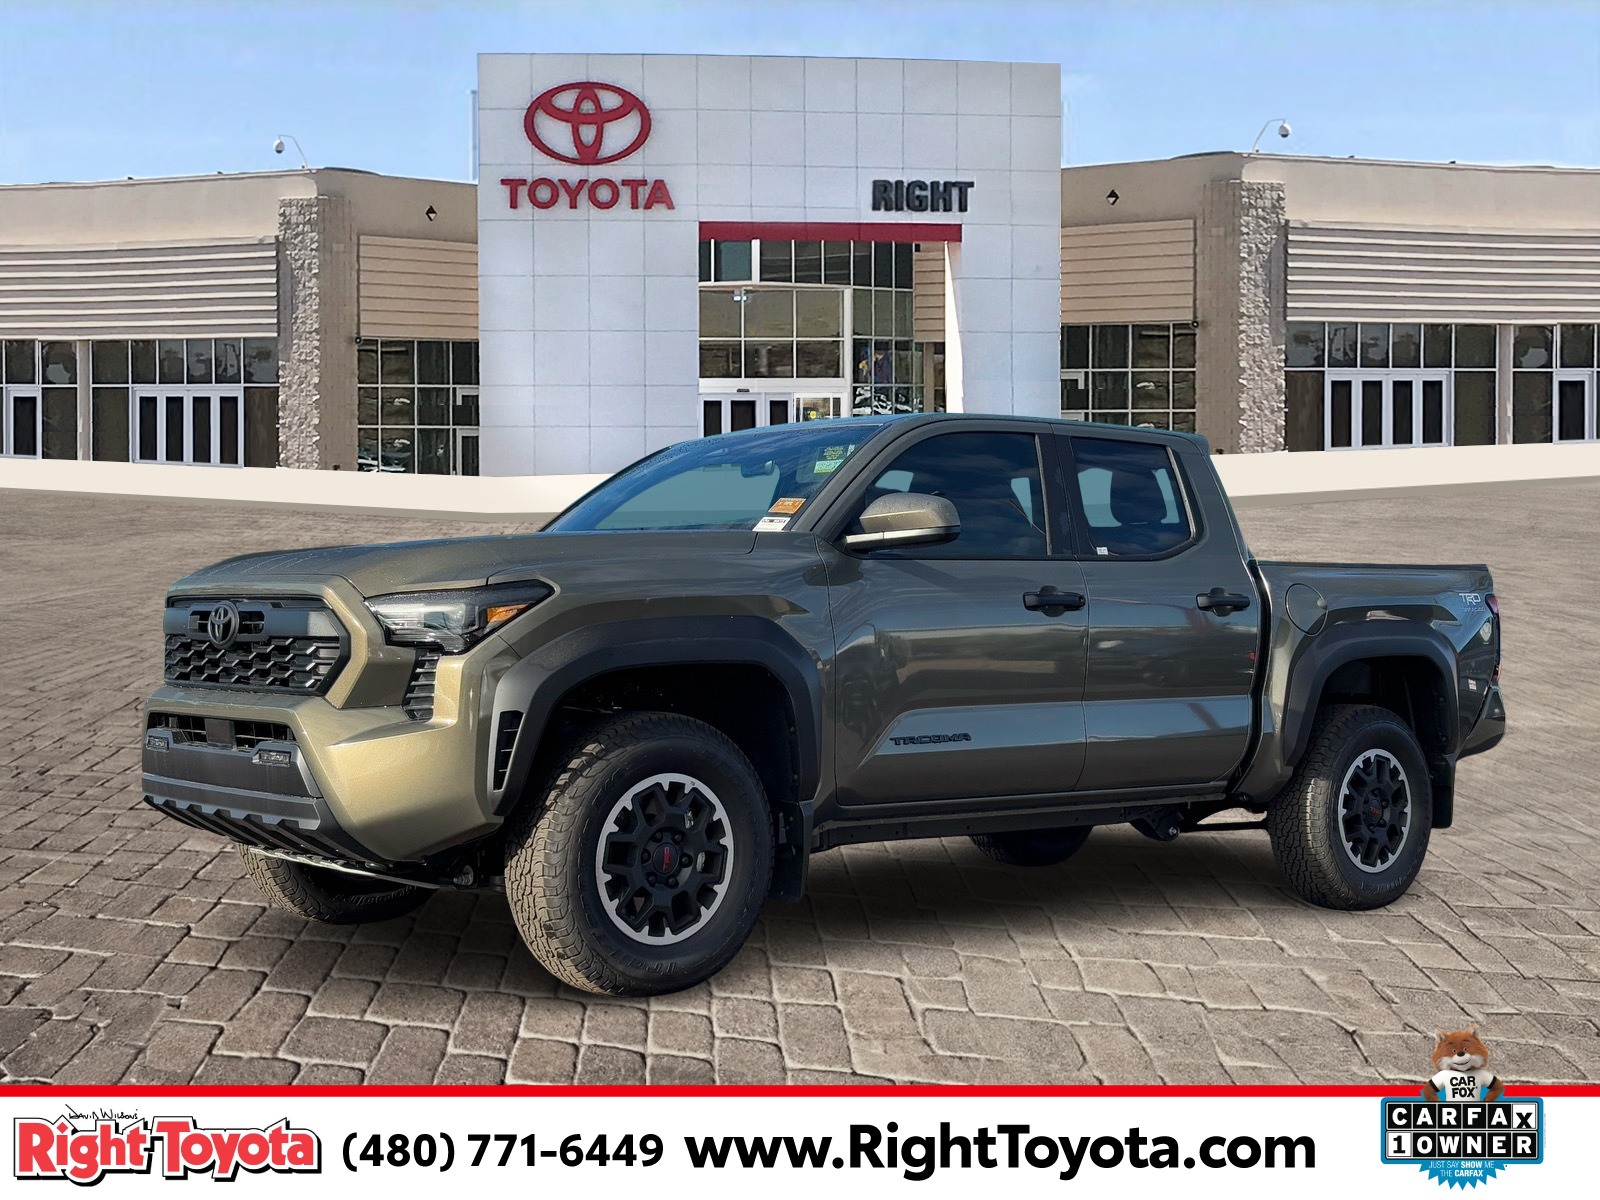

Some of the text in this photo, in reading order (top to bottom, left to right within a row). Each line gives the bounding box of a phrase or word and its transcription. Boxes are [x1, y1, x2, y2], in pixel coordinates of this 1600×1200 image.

[501, 179, 674, 210] TOYOTA
[871, 179, 975, 212] RIGHT
[1459, 593, 1481, 605] TRD
[890, 733, 972, 745] TACOMA
